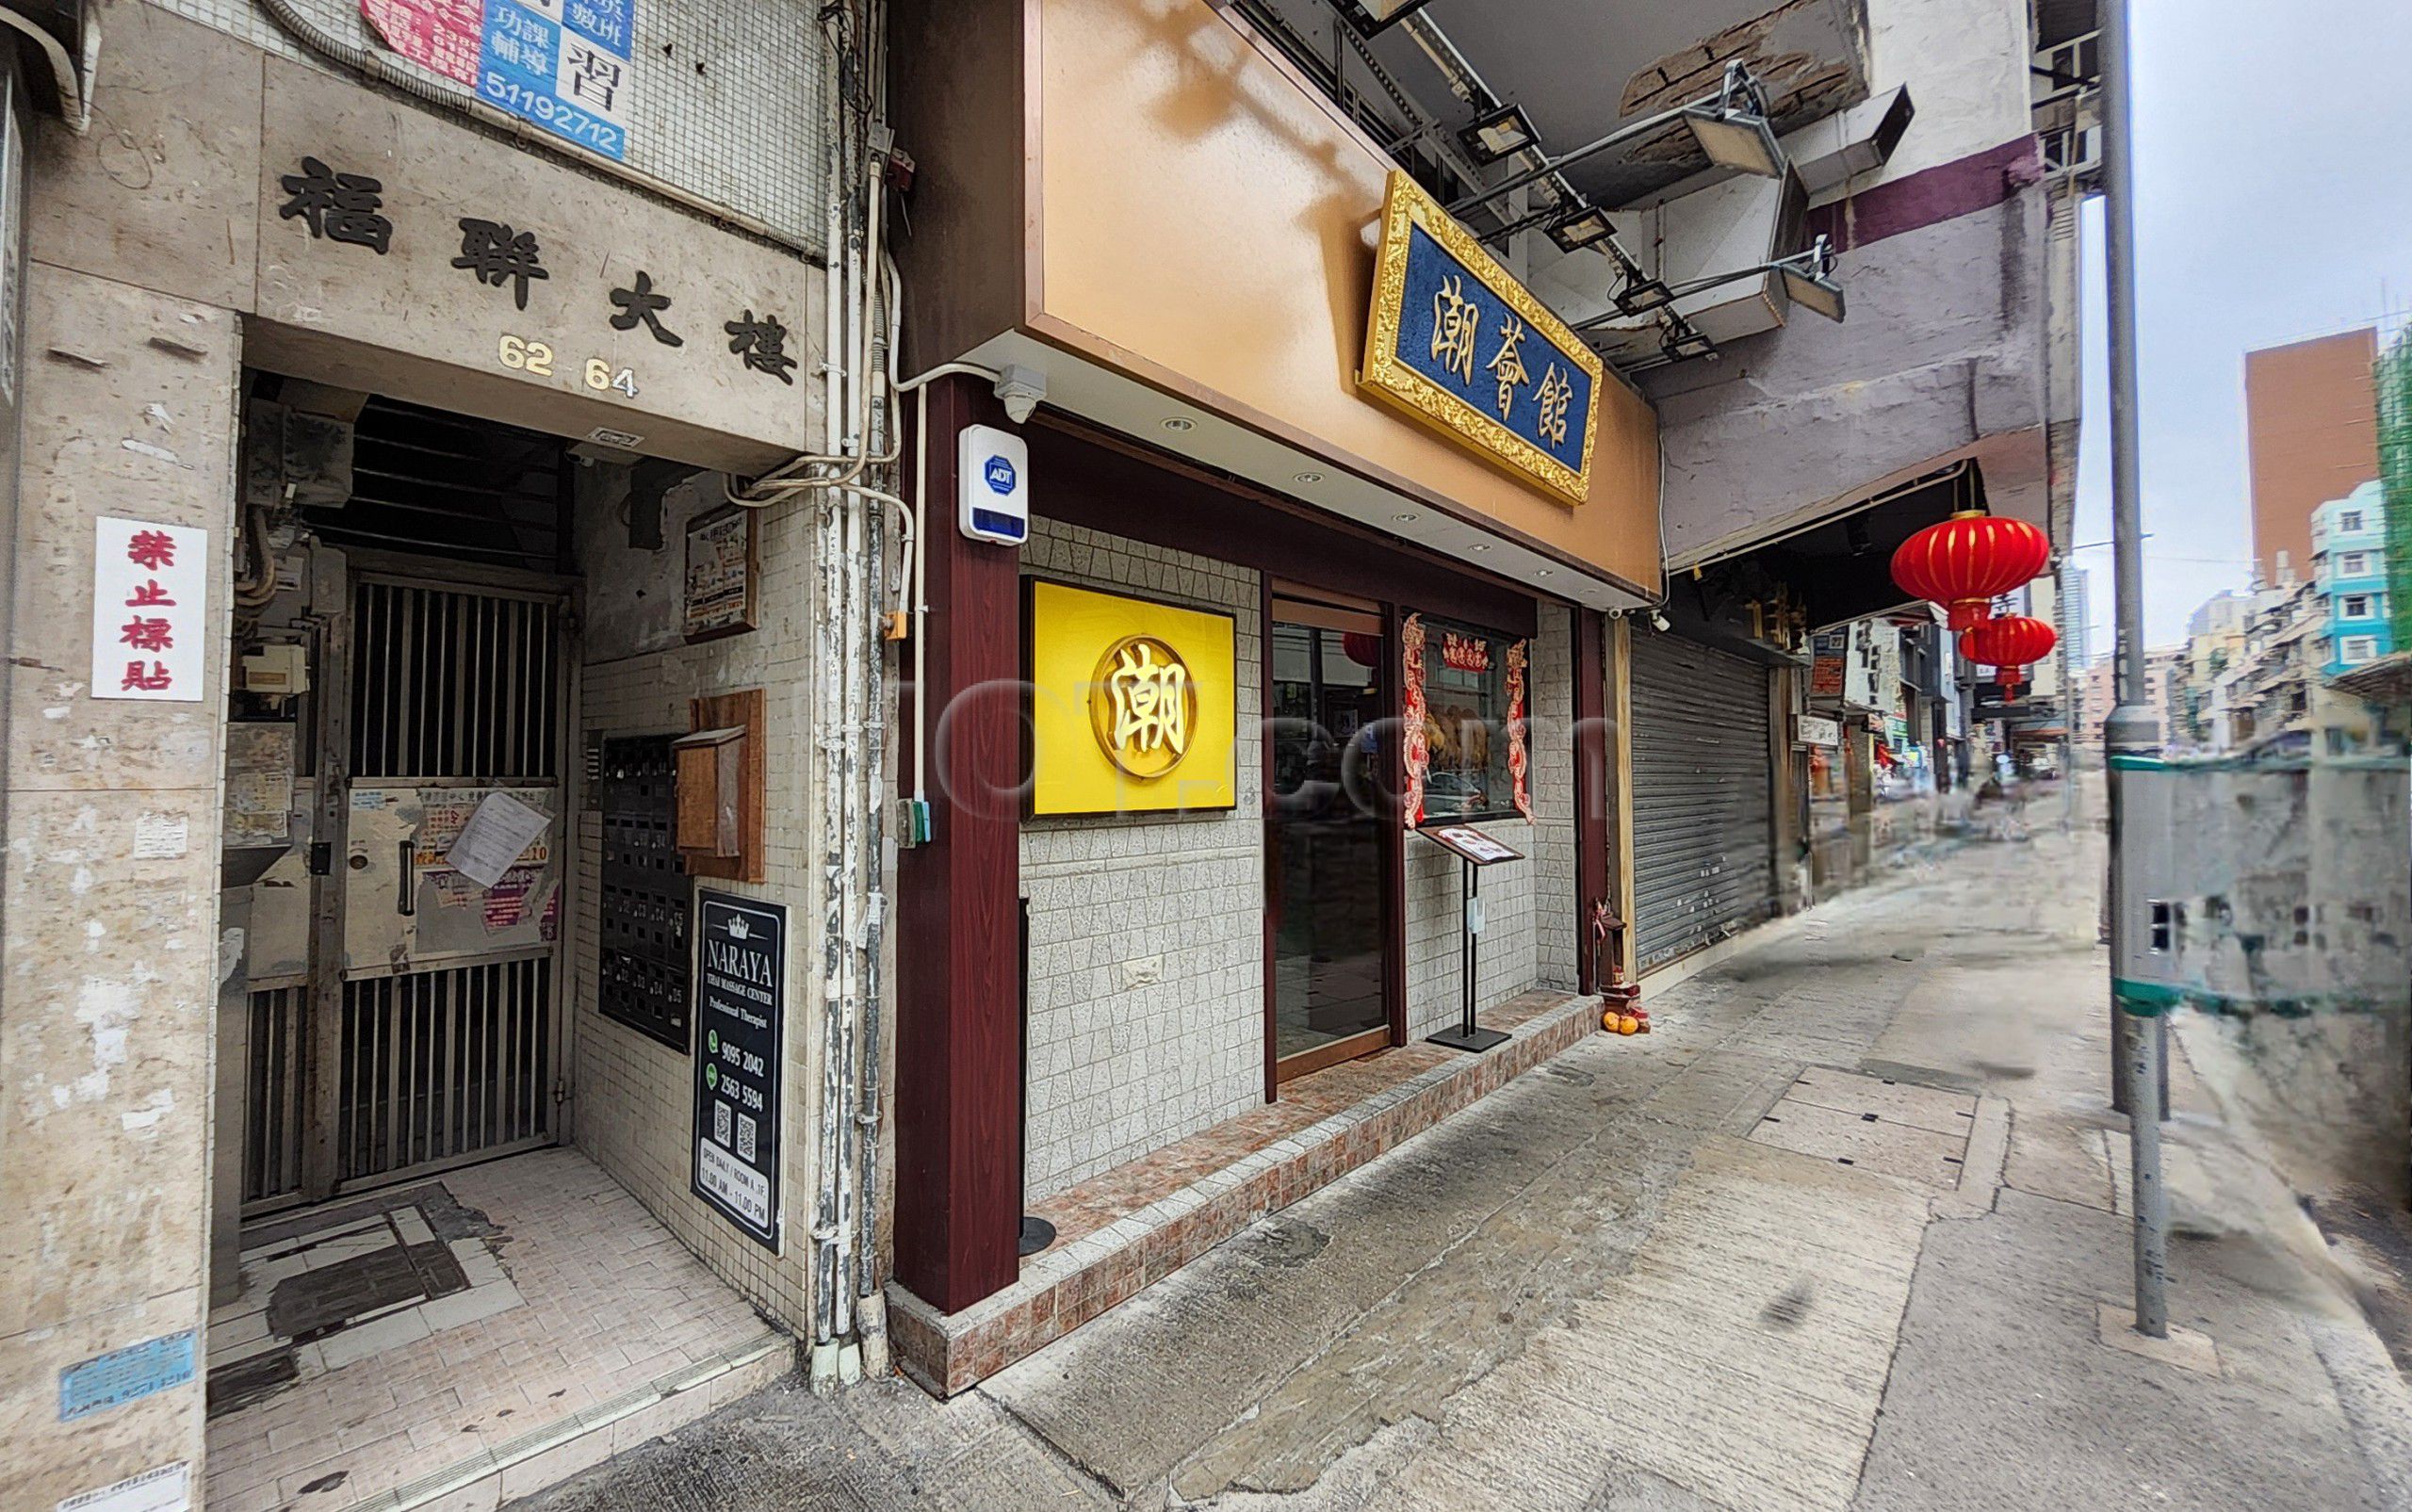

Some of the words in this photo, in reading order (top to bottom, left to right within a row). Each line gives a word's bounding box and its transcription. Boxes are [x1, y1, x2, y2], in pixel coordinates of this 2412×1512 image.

[495, 7, 550, 50] 功課
[491, 30, 550, 76] 輔導
[566, 43, 623, 112] 習
[486, 71, 617, 153] 51192712
[497, 334, 555, 377] 62
[584, 357, 641, 399] 64
[990, 467, 1013, 484] ADT
[119, 529, 178, 692] 禁止標貼
[1109, 643, 1186, 756] 潮
[708, 939, 774, 987] NARAYA
[707, 973, 721, 987] THAI
[721, 978, 747, 998] MASSAGE
[747, 987, 774, 1006] CENTER
[709, 996, 740, 1018] Professional
[740, 1007, 768, 1030] Therapist
[722, 1041, 741, 1066] 9095
[742, 1050, 765, 1078] 2042
[721, 1074, 740, 1100] 2563
[742, 1084, 763, 1113] 5594
[703, 1147, 715, 1164] OPEN
[716, 1156, 730, 1174] DAILY
[734, 1167, 750, 1188] ROOM
[718, 1179, 729, 1195] AM
[754, 1202, 766, 1222] PM
